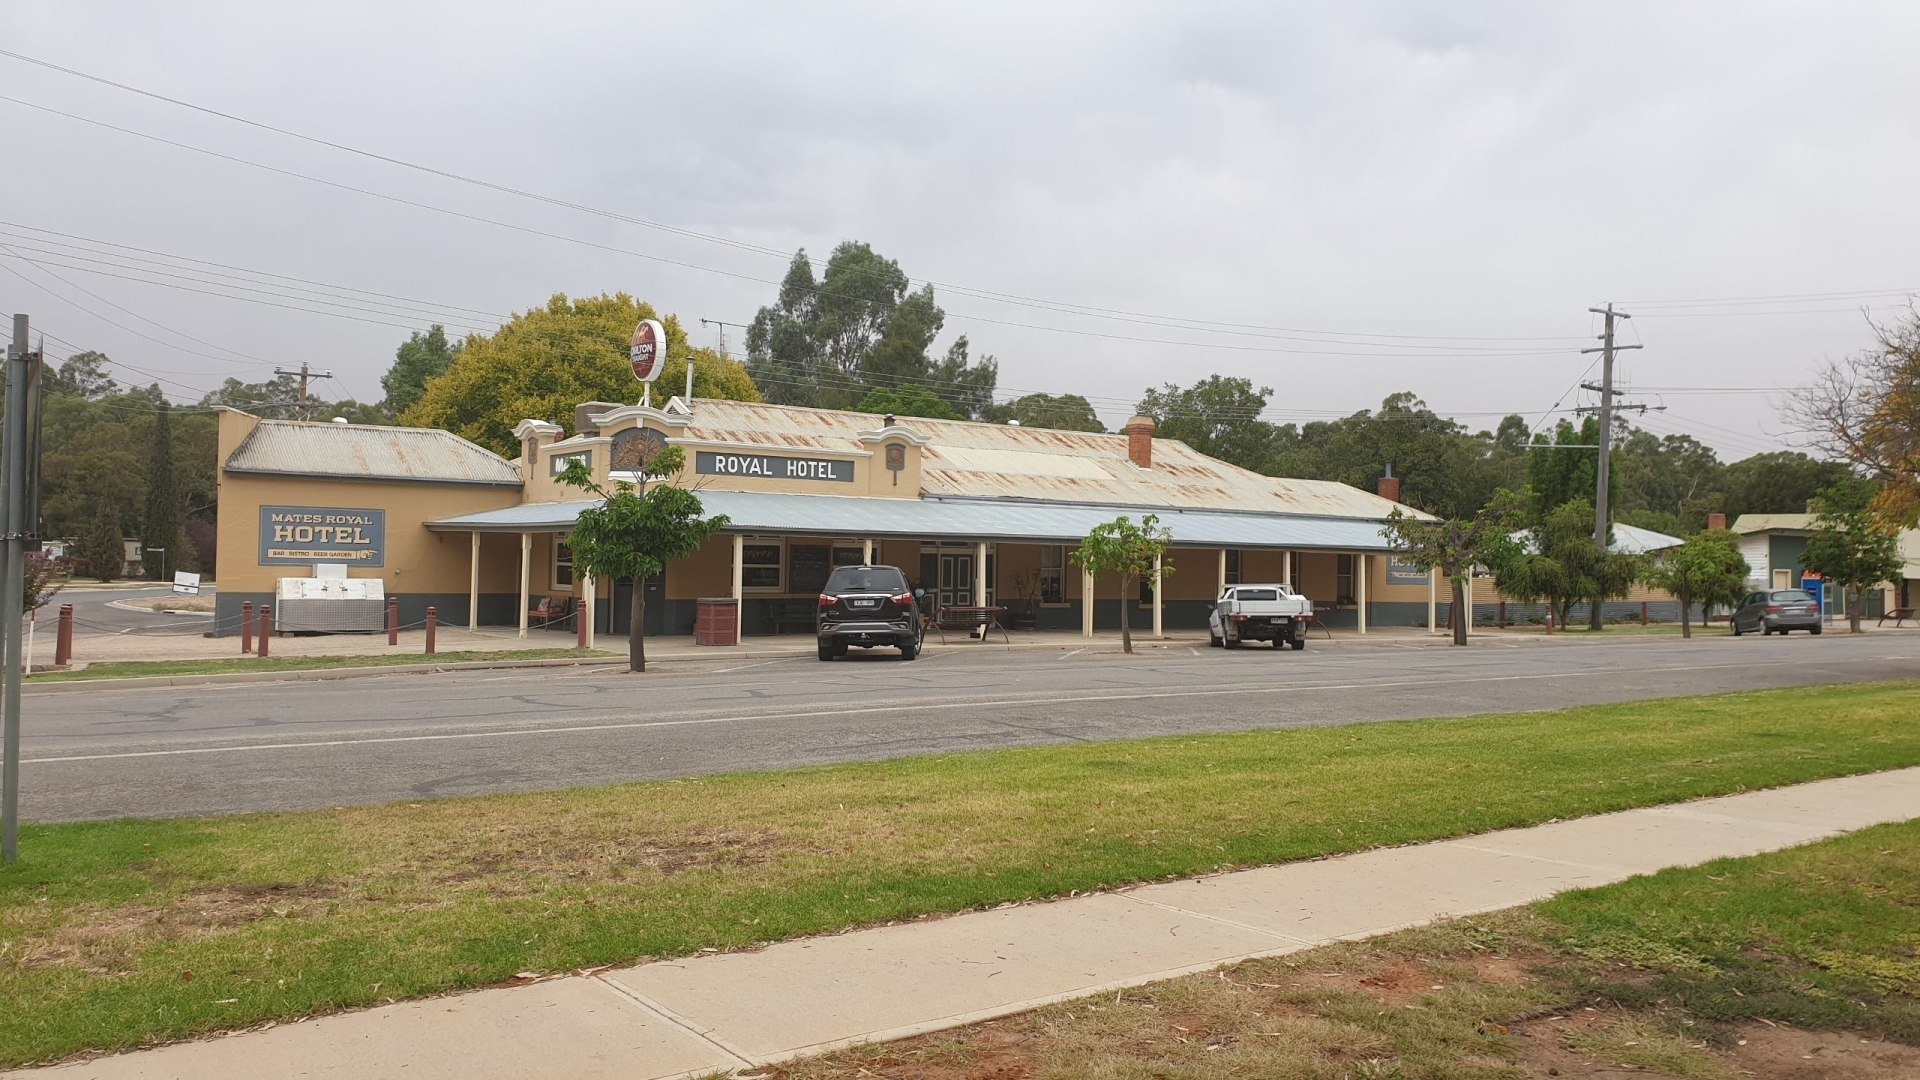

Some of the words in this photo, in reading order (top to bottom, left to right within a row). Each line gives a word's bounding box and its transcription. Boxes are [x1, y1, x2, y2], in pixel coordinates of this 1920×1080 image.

[631, 343, 653, 356] LTON
[555, 454, 586, 473] MAS
[715, 455, 773, 476] ROYAL
[787, 460, 837, 479] HOTEL
[272, 513, 322, 523] MATES
[326, 515, 373, 525] ROYAL
[273, 525, 371, 544] HOTEL
